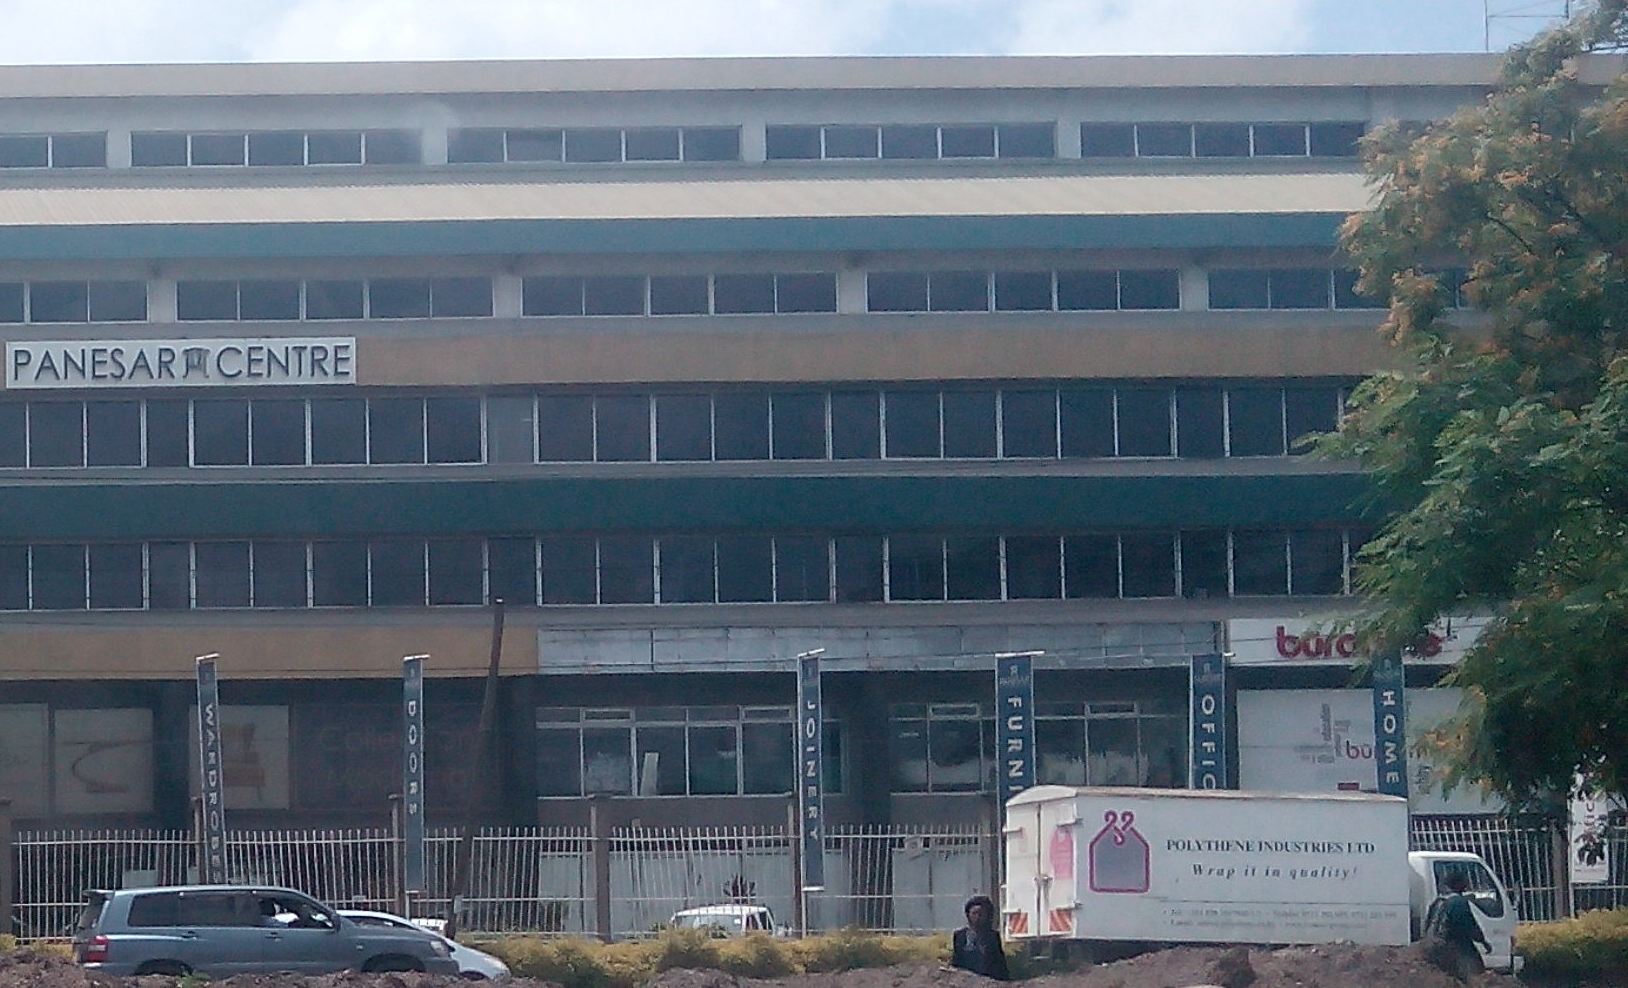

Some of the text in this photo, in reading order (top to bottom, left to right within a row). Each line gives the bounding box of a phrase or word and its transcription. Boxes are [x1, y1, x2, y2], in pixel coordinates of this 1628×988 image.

[13, 344, 351, 381] PANESAR CENTRE
[408, 701, 418, 814] DOORS
[1382, 690, 1400, 784] HOME
[805, 700, 819, 841] JOINERY
[1166, 839, 1375, 853] POLYTHENE INDUSTRIES LTD
[1192, 863, 1236, 880] Wrap
[1244, 865, 1256, 877] it
[1265, 866, 1281, 878] in
